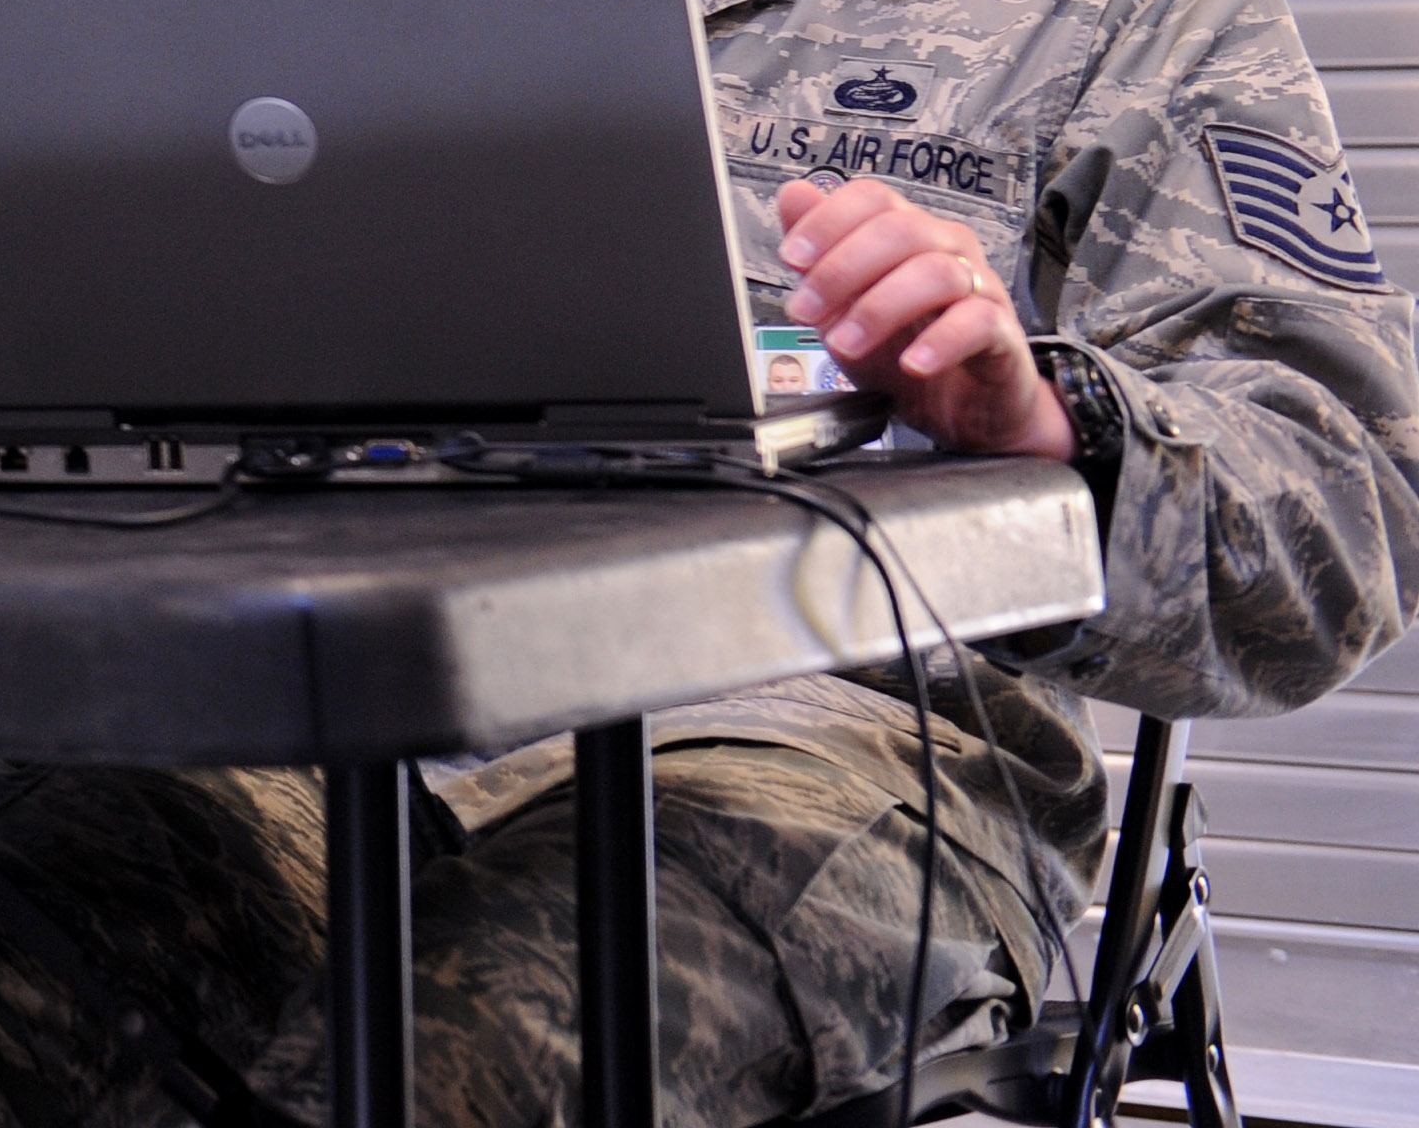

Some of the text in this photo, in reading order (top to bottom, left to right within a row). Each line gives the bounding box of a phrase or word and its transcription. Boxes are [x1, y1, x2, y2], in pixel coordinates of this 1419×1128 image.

[750, 121, 995, 195] U.S. AIR FORCE
